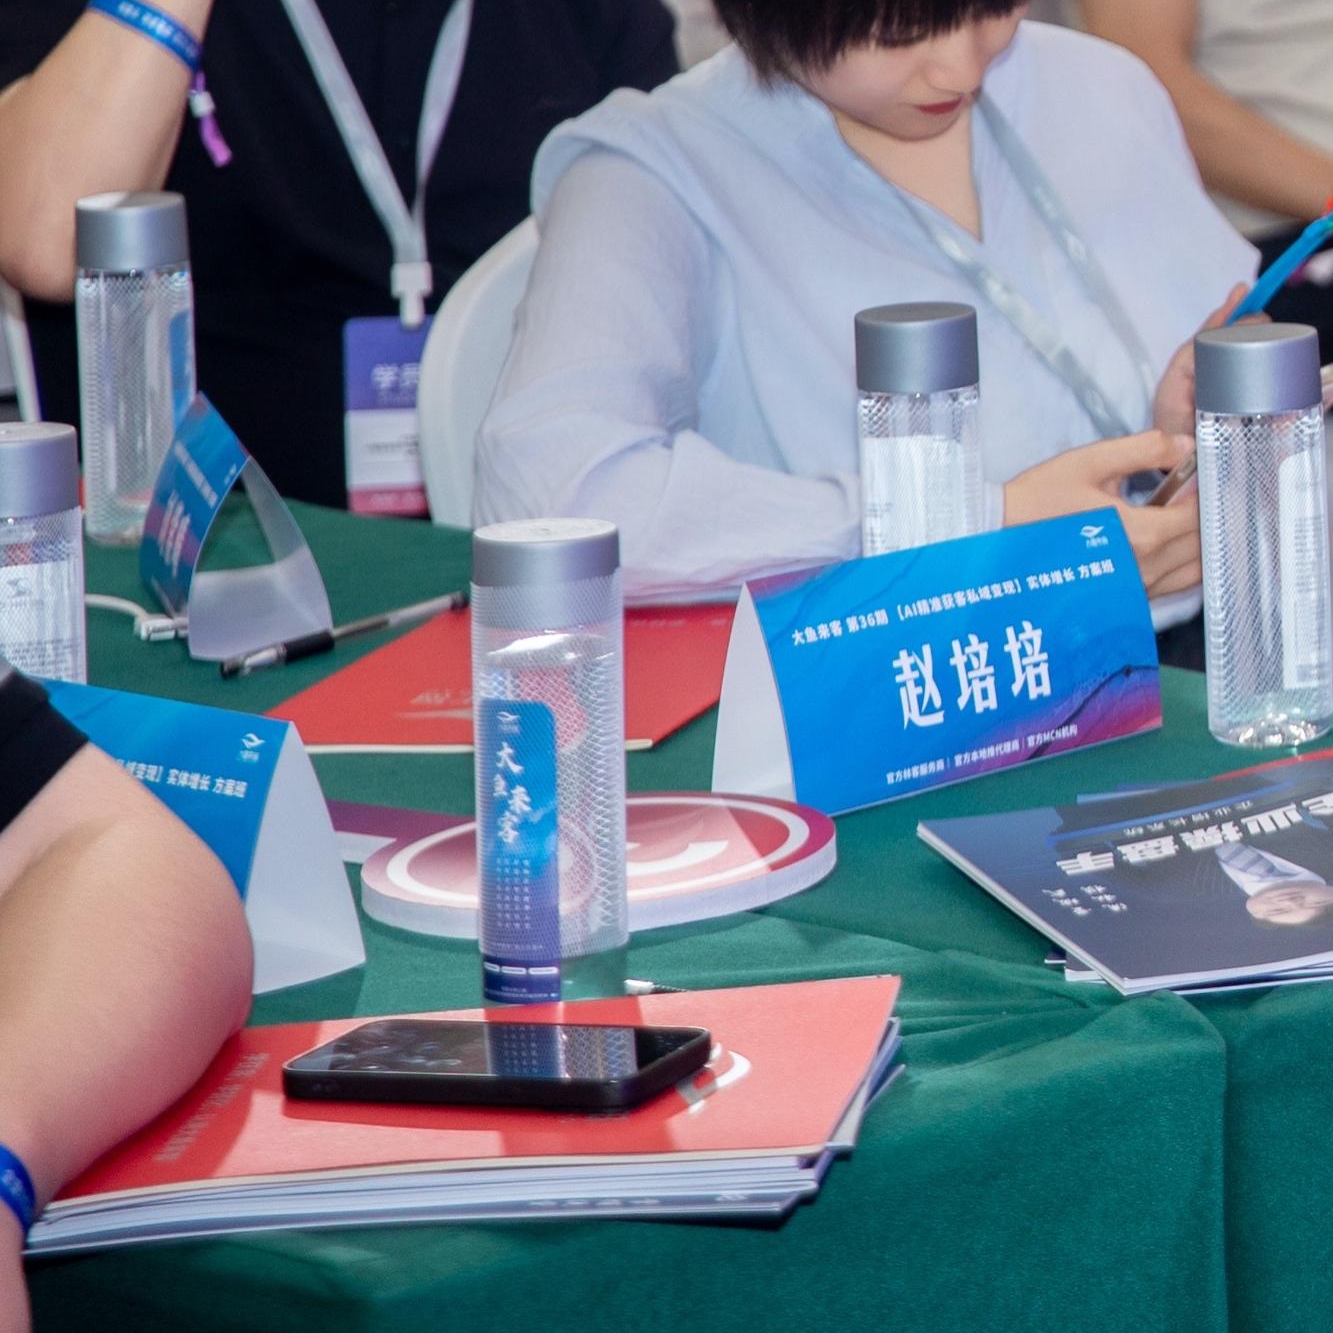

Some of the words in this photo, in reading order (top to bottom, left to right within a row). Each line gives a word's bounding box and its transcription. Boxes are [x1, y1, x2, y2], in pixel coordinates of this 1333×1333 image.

[792, 619, 843, 646] 大鱼来客
[846, 608, 889, 634] 第36期
[1027, 567, 1076, 591] 实体增长
[1078, 558, 1115, 580] 方案班
[891, 619, 1053, 730] 赵培培
